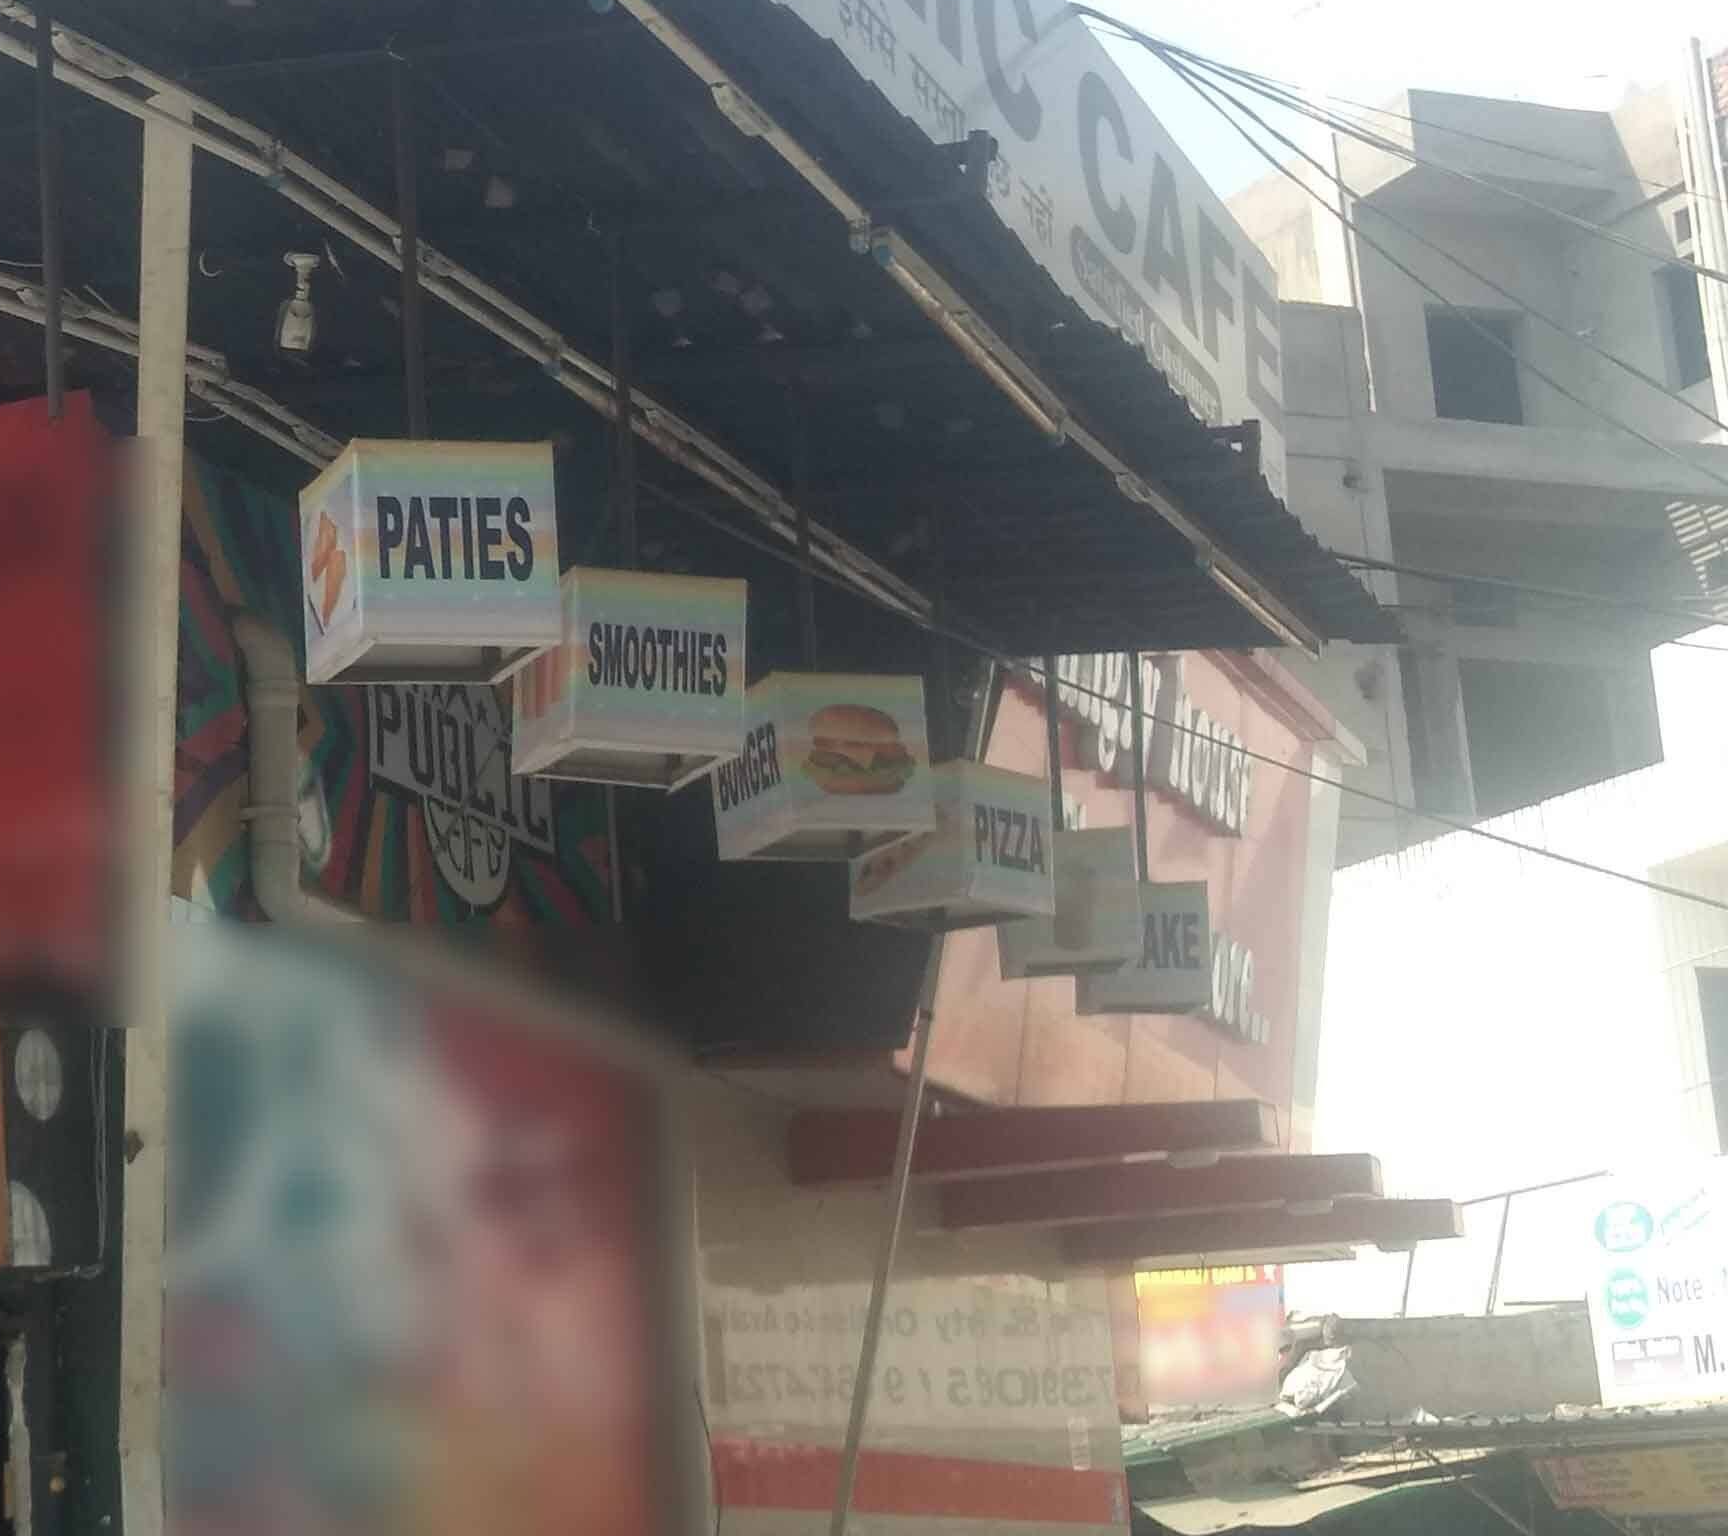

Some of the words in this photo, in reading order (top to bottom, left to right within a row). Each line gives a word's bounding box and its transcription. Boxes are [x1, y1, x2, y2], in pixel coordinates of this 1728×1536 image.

[1077, 71, 1282, 434] CAFE
[376, 494, 535, 582] PATIES
[587, 621, 728, 697] SMOOTHIES
[718, 722, 781, 812] BURGER
[973, 802, 1046, 875] PIZZA
